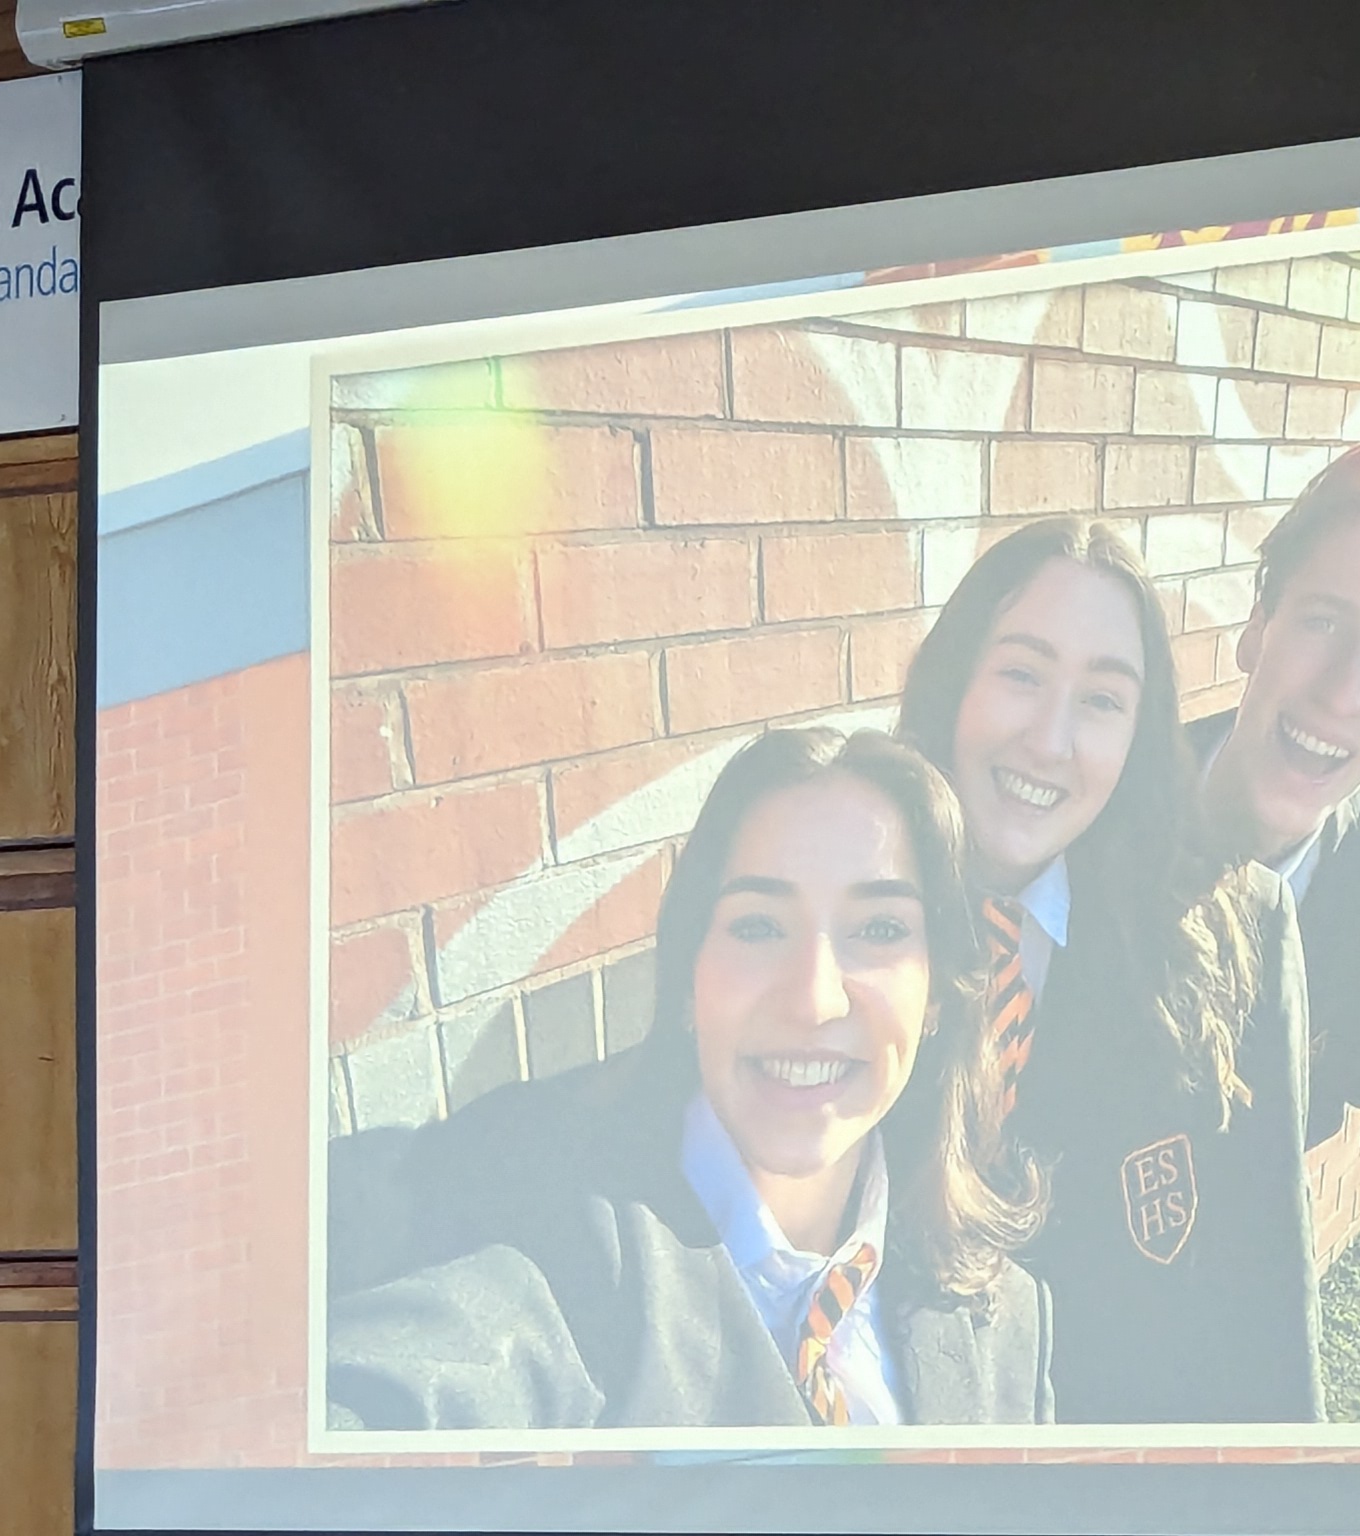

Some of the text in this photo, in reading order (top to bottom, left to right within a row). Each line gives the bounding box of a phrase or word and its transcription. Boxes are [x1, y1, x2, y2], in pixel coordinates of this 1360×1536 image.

[11, 167, 78, 229] Ac
[1134, 1148, 1179, 1197] ES
[1140, 1191, 1188, 1242] HS
